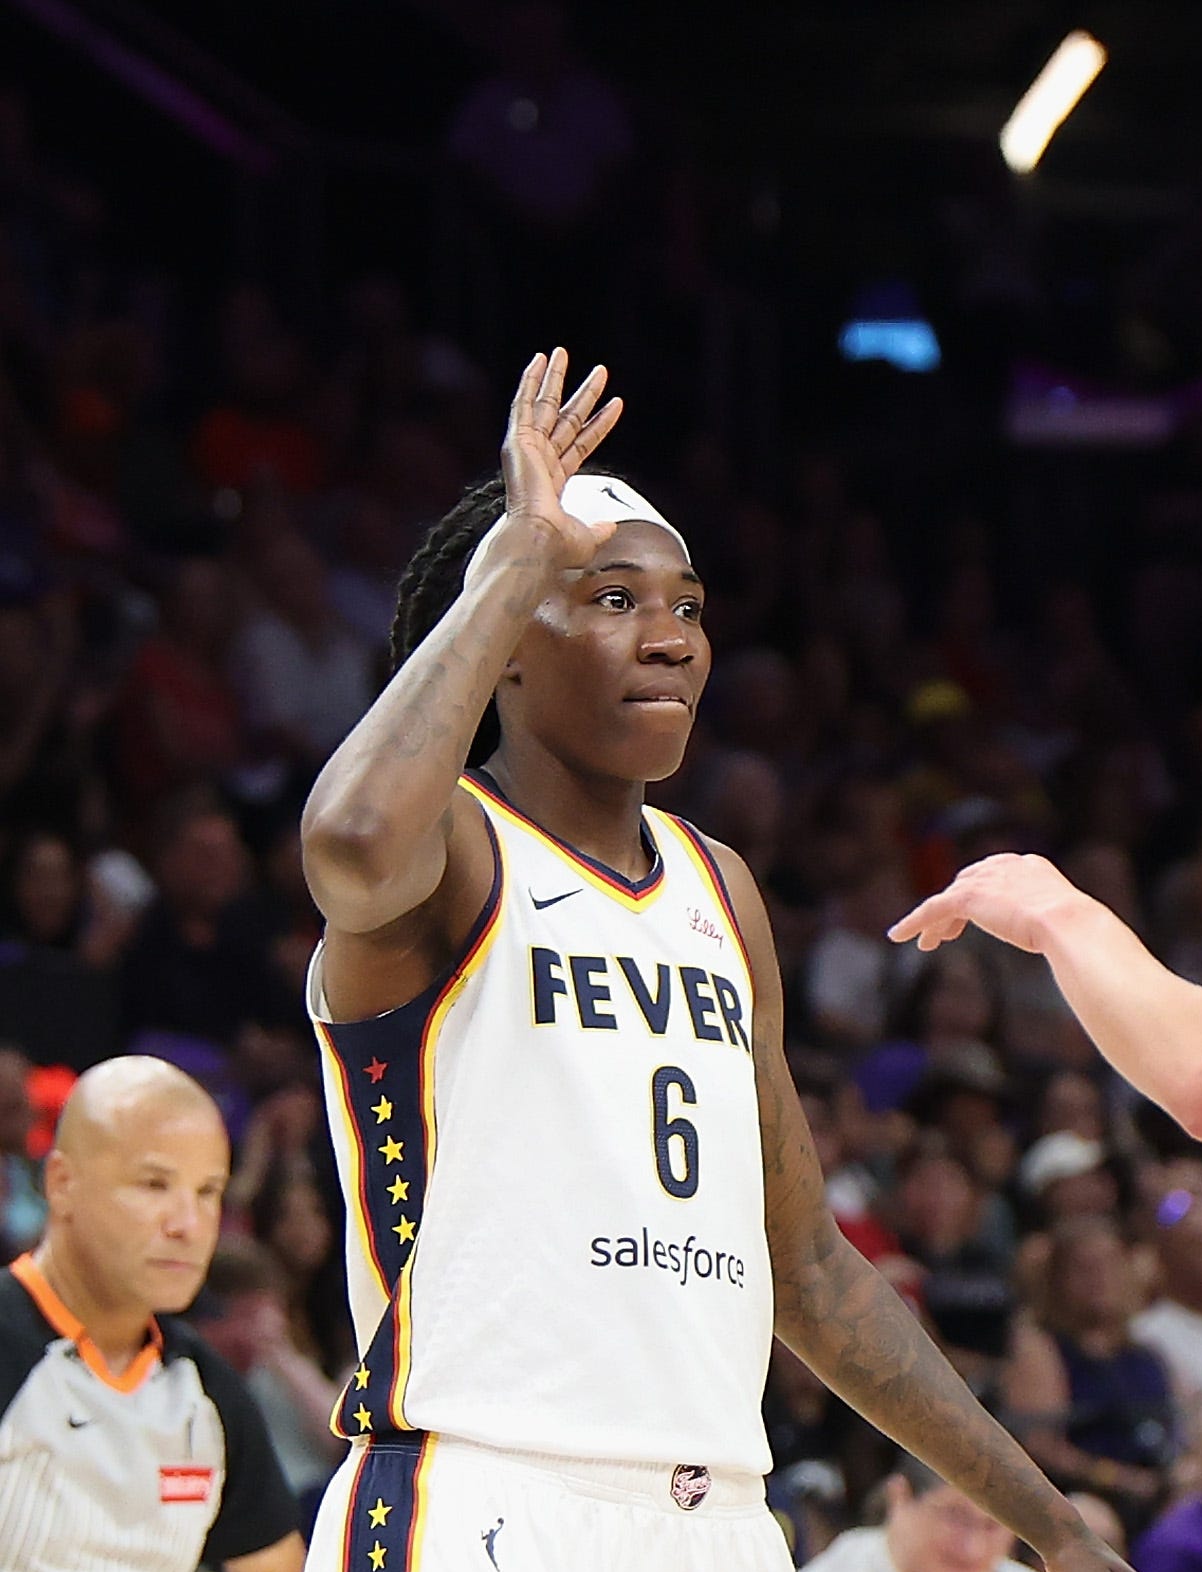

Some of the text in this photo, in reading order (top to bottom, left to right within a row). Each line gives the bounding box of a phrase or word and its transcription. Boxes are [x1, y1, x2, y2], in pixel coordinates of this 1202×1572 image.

[687, 907, 723, 949] Lilly
[529, 945, 751, 1054] FEVER
[650, 1065, 699, 1200] 6
[590, 1227, 744, 1288] salesforce
